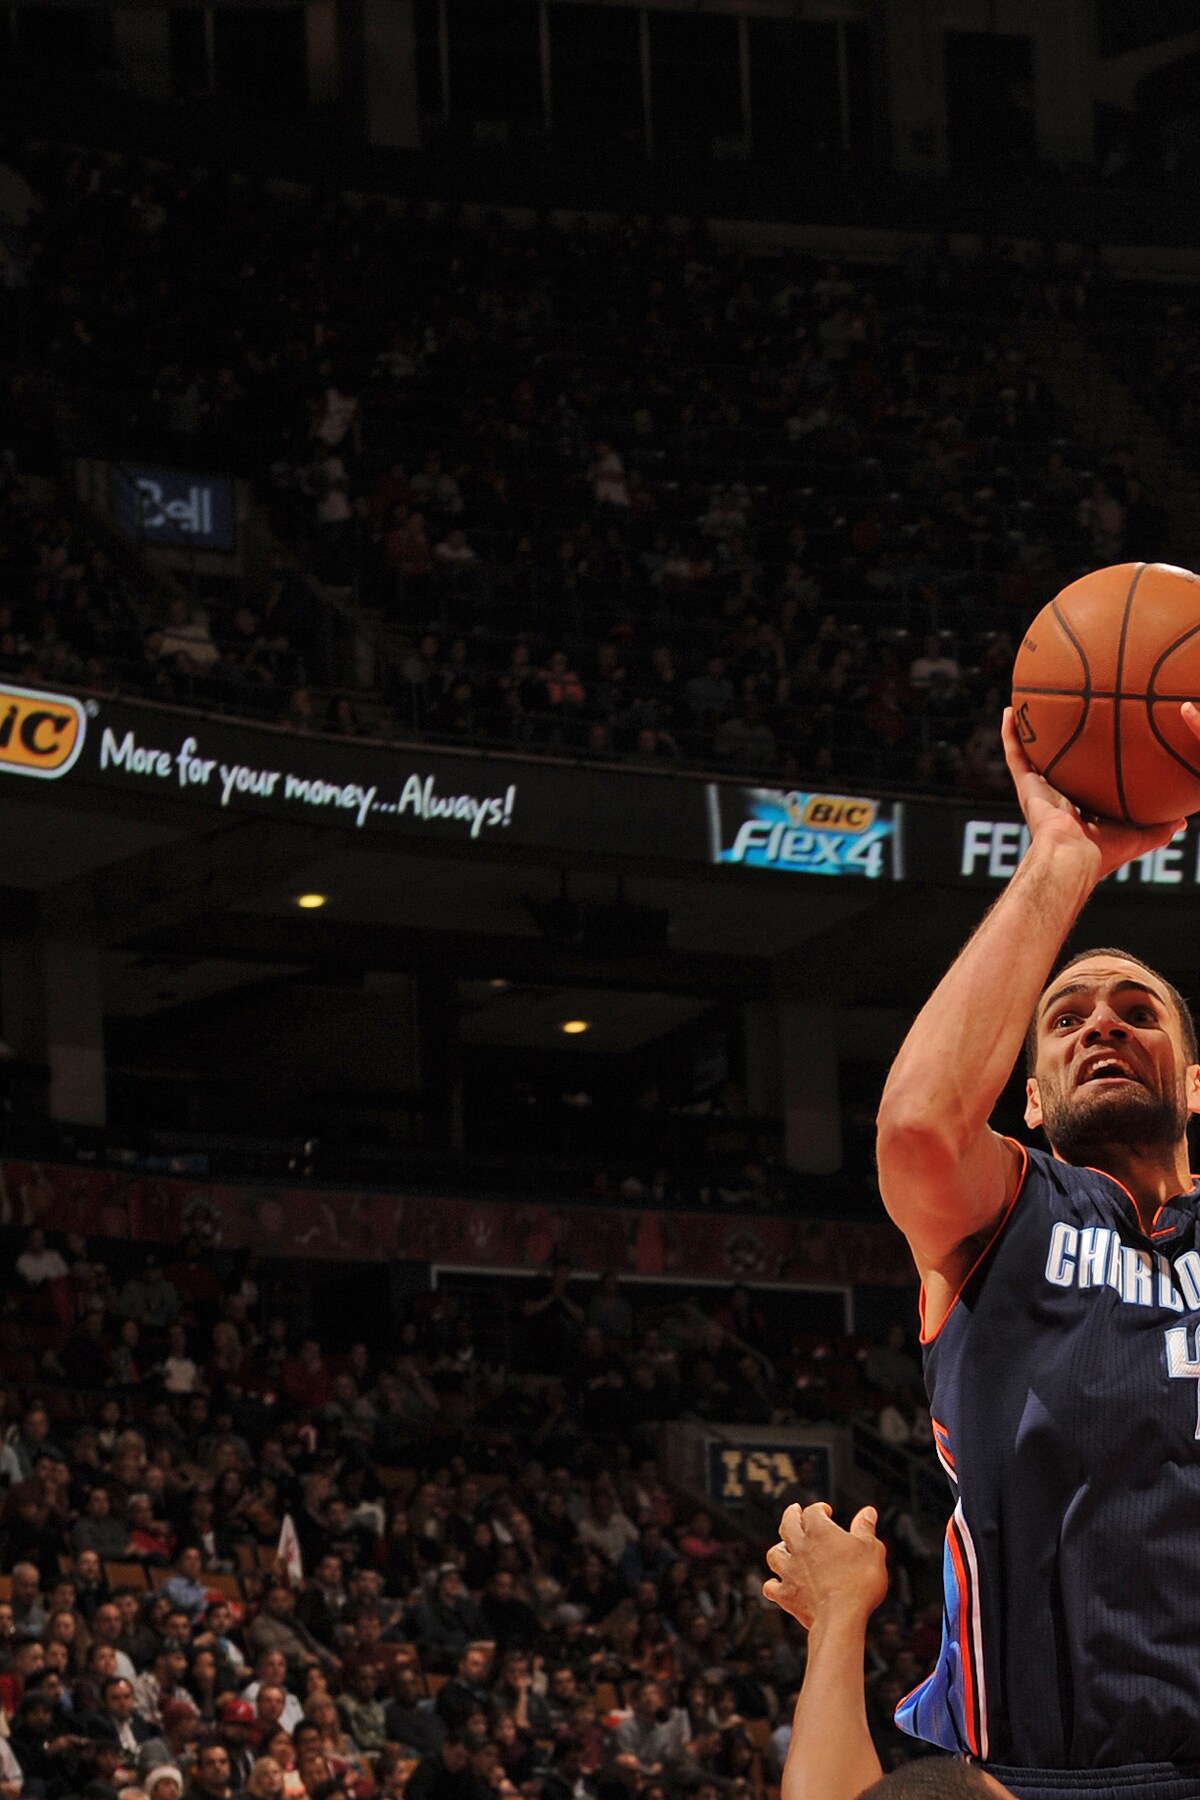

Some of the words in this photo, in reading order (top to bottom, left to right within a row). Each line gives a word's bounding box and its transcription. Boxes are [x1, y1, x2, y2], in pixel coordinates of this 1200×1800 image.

[100, 726, 171, 777] More
[176, 736, 217, 787] for
[219, 763, 280, 806] your
